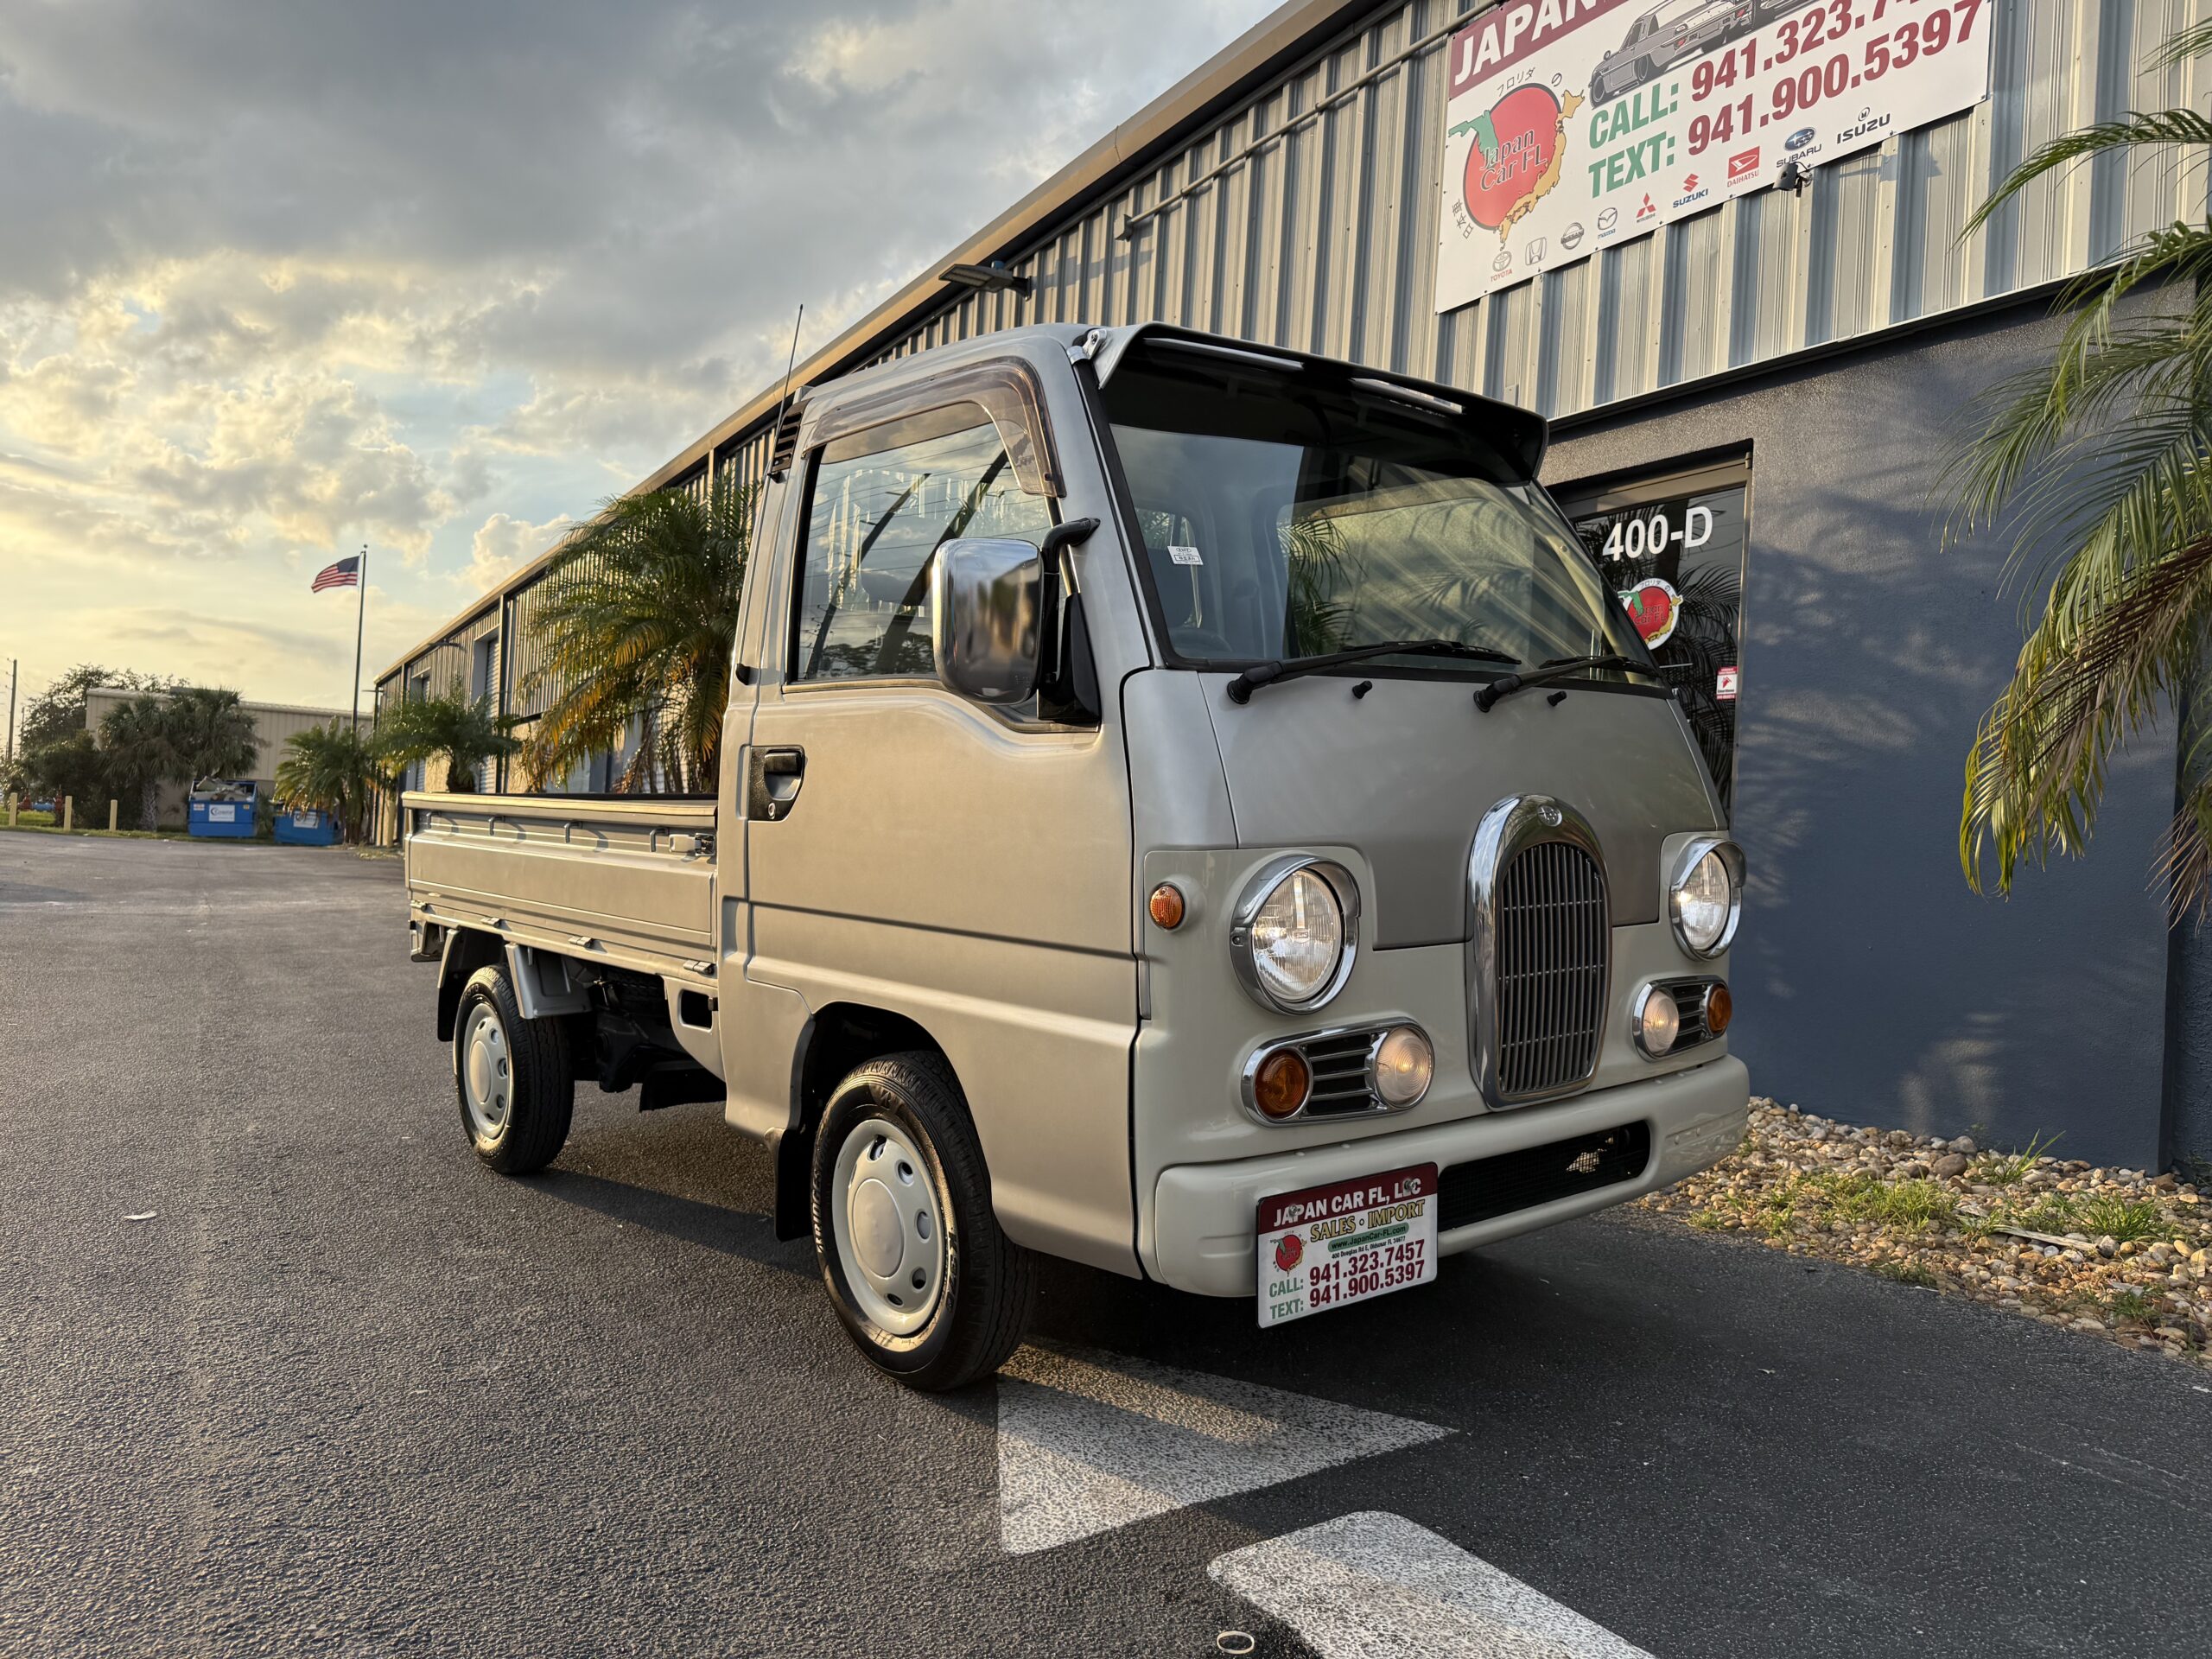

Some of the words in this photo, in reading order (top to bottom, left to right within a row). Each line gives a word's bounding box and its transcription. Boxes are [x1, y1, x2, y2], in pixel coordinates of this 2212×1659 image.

[1497, 67, 1535, 97] フロリダ
[1551, 73, 1562, 87] の
[1589, 82, 1679, 149] CALL:
[1691, 0, 1919, 102] 941.323.
[1588, 130, 1675, 199] TEXT:
[1688, 0, 1982, 156] 941.900.5397
[1836, 113, 1891, 144] ISUZU
[1479, 129, 1535, 170] Japan
[1480, 160, 1518, 192] Car
[1522, 143, 1549, 174] FL
[1776, 143, 1822, 168] SUBARU
[1673, 188, 1708, 208] SUZUKI
[1727, 170, 1759, 188] DAIHATSU
[1491, 269, 1513, 282] TOYOTA
[1602, 506, 1713, 562] 400-D
[1274, 1198, 1327, 1227] JAPAN
[1332, 1191, 1364, 1213] CAR
[1368, 1186, 1390, 1205] FL,
[1310, 1216, 1356, 1243] SALES
[1368, 1198, 1426, 1229] IMPORT
[1331, 1225, 1406, 1249] www.JapanCar-FL.com
[1269, 1278, 1304, 1298] CALL:
[1310, 1239, 1425, 1286] 941.323.7457
[1269, 1298, 1304, 1319] TEXT:
[1310, 1260, 1425, 1308] 941.900.5397
